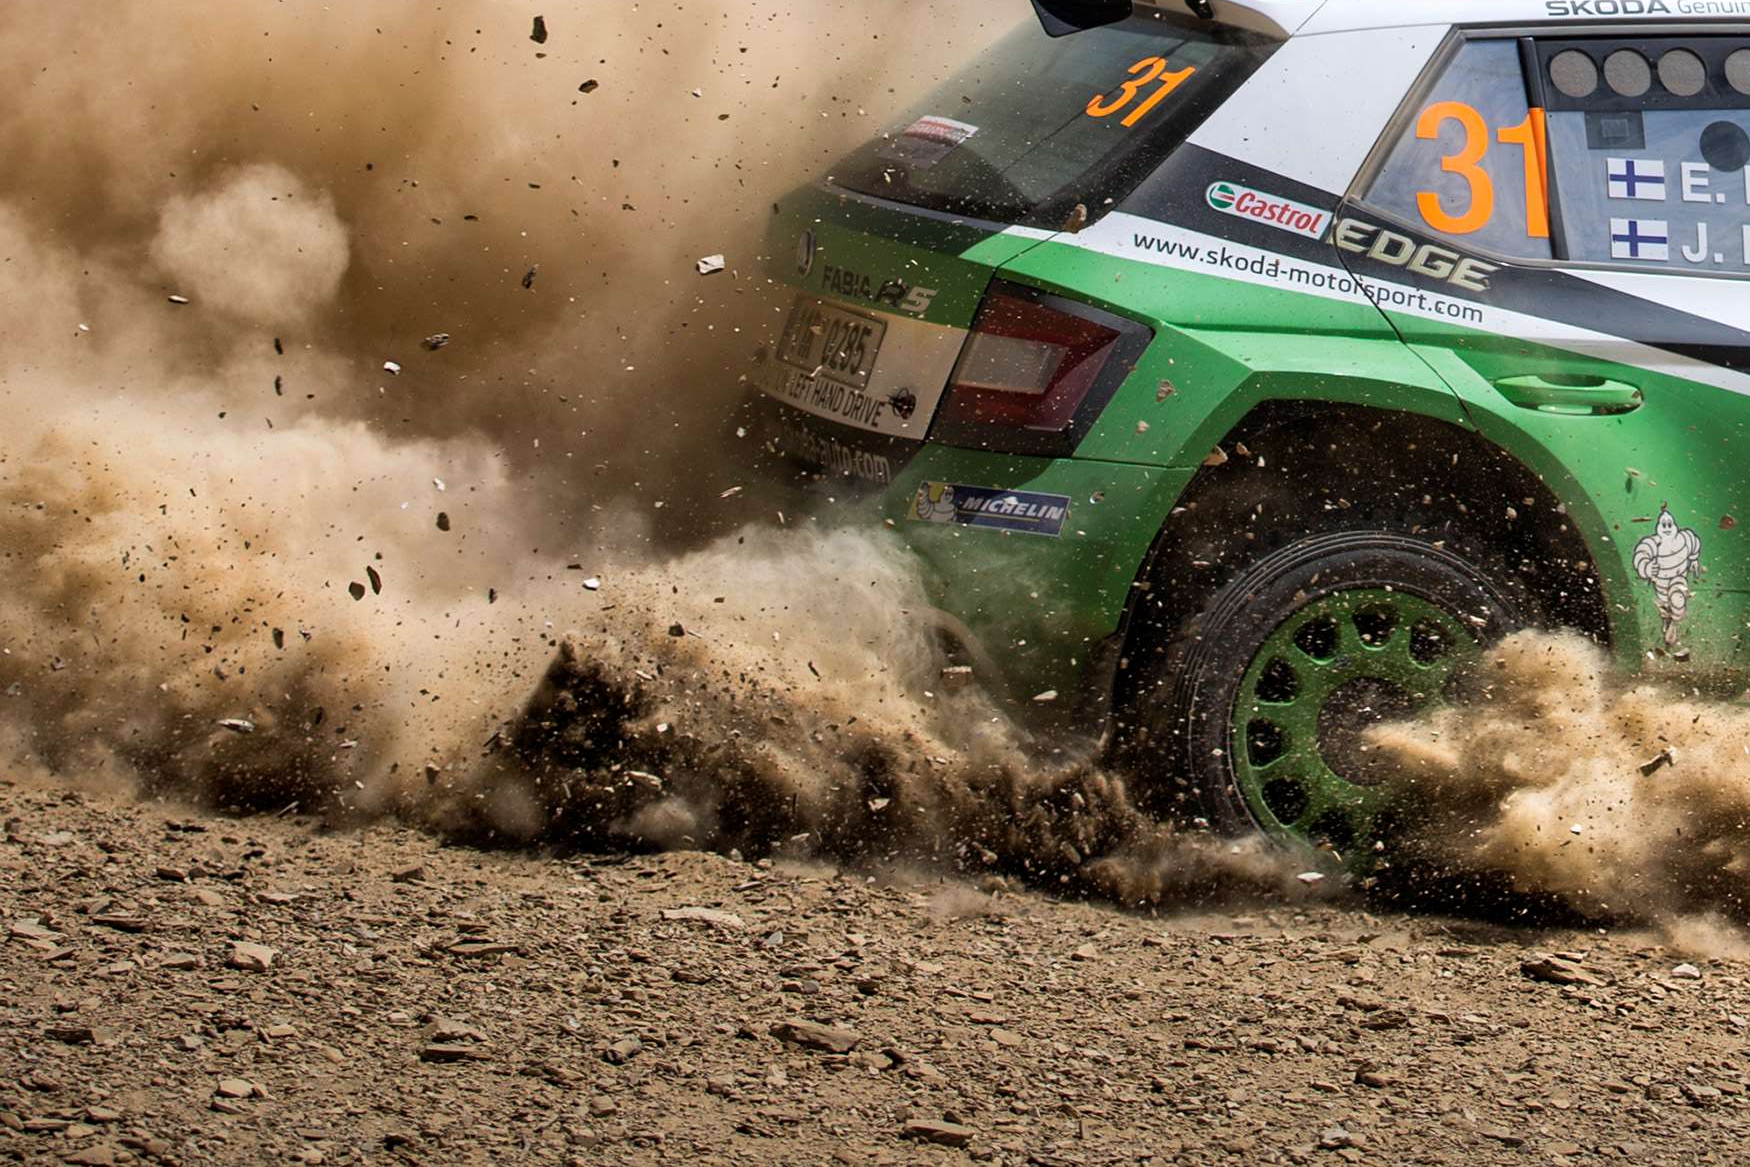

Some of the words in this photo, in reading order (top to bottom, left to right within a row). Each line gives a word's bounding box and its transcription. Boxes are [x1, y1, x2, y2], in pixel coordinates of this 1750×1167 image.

[1085, 56, 1197, 128] 31
[1415, 100, 1550, 238] 31
[1680, 161, 1727, 204] E.
[1234, 189, 1325, 235] Castrol
[1326, 217, 1502, 292] EDGE
[1681, 222, 1724, 264] J.
[822, 265, 873, 302] FABIA
[1134, 232, 1484, 324] www.skoda-motorsport.com
[811, 377, 845, 412] HAND
[842, 389, 885, 428] DRIVE
[962, 496, 1065, 522] MICHELIN
